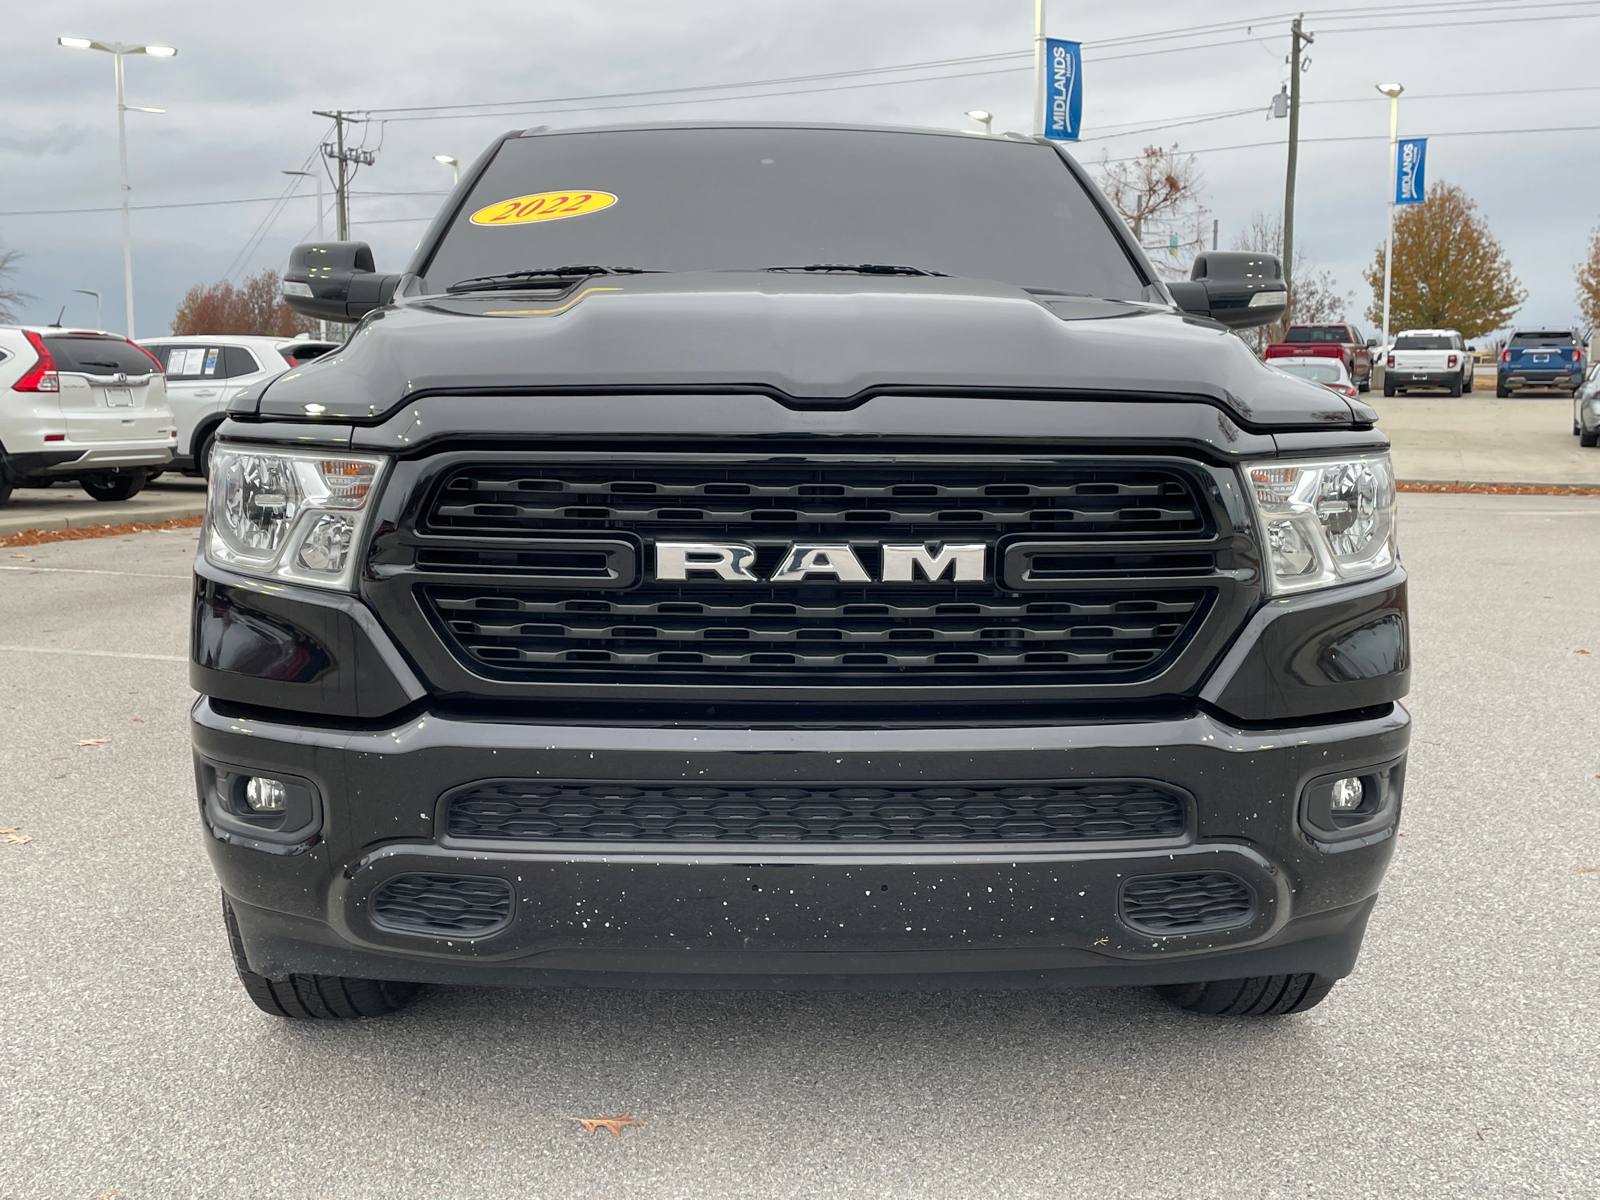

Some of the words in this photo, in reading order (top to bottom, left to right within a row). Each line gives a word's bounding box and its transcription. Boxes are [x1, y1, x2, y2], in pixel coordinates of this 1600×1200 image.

[1052, 46, 1065, 130] MIDLANDS
[1401, 143, 1413, 199] MIDLANDS
[489, 194, 592, 222] 2022
[654, 541, 988, 583] RAM
